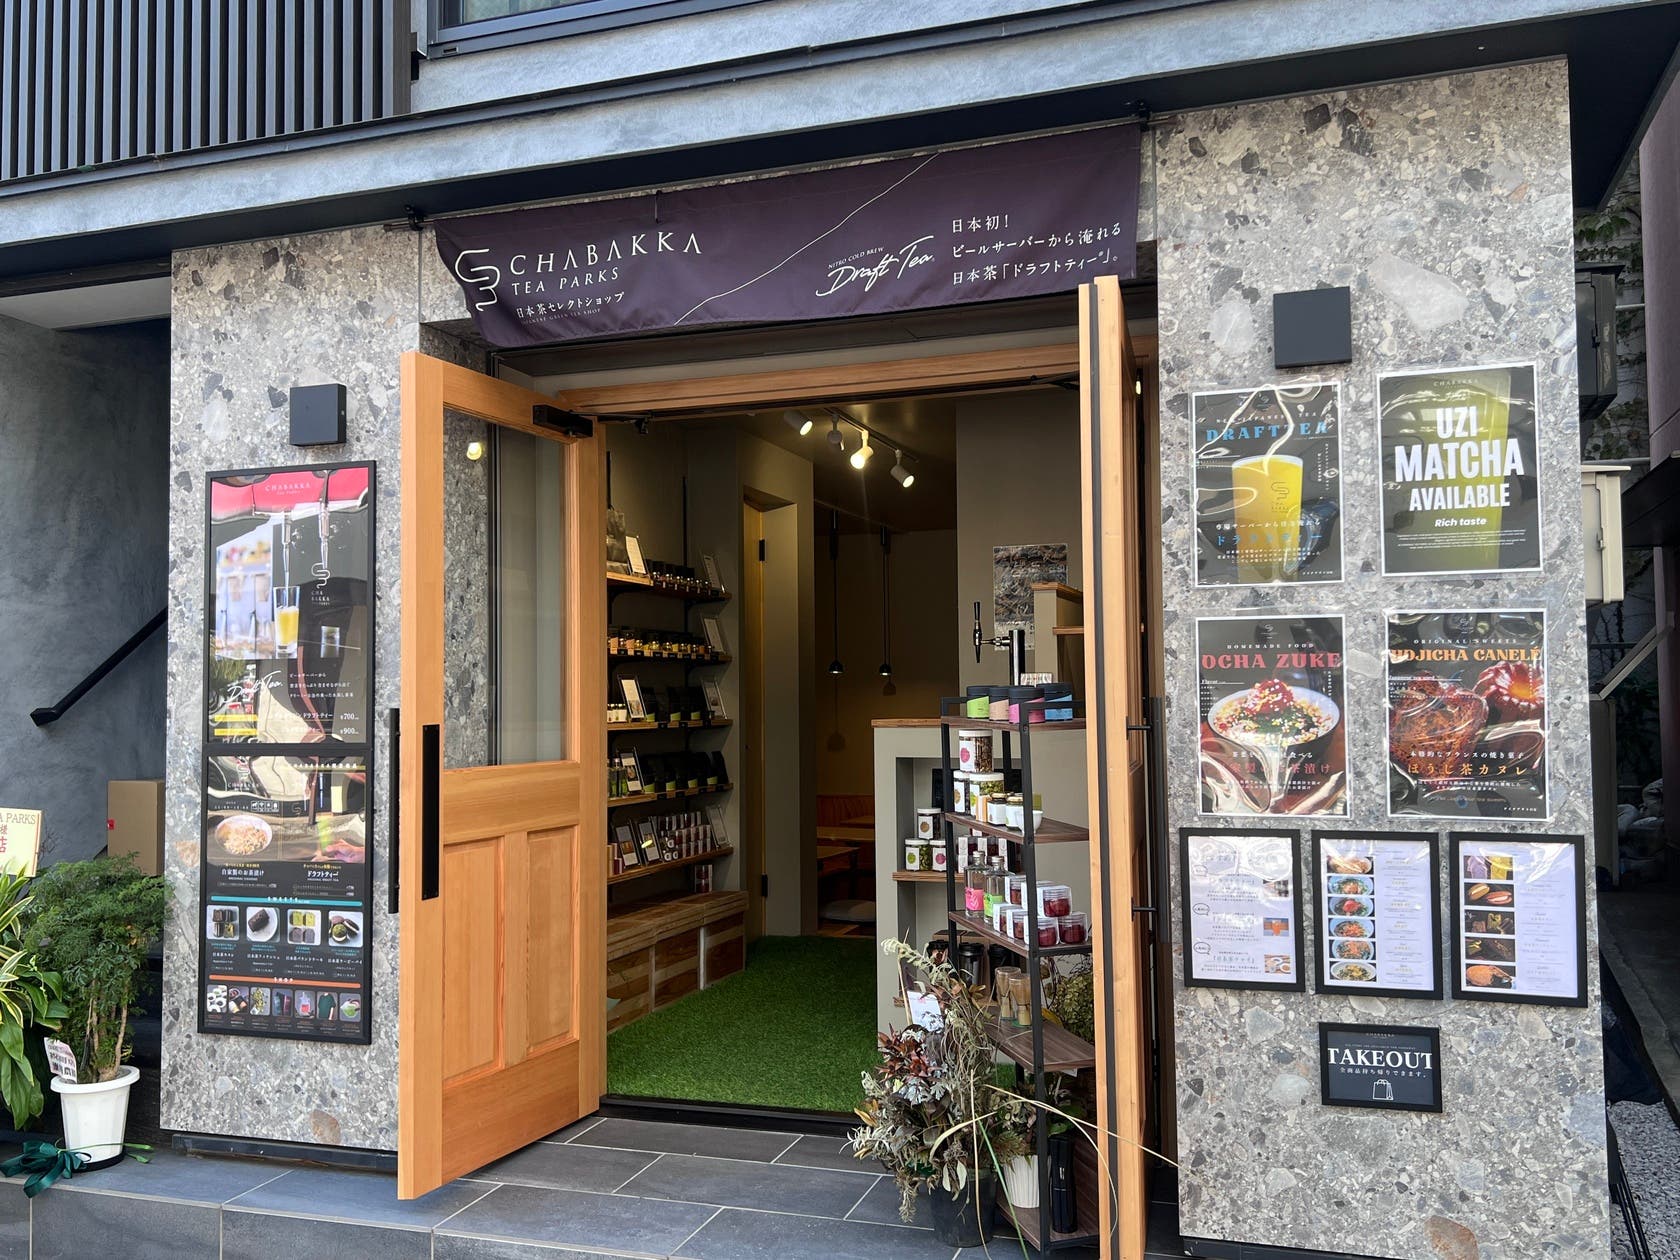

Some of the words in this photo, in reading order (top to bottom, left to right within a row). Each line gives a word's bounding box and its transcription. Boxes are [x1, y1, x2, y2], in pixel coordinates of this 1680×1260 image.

[509, 231, 702, 276] CHABAKKA
[952, 222, 1121, 259] ビールサーバーから淹れる
[815, 253, 899, 297] Draft
[897, 235, 934, 279] Tea
[828, 258, 847, 268] NITRO
[847, 251, 865, 262] COLD
[866, 246, 884, 256] BREW
[512, 281, 545, 296] TEA
[559, 266, 620, 290] PARKS
[516, 291, 625, 319] 日本茶セレクトショップ
[1206, 424, 1280, 442] DRAFT
[1283, 419, 1329, 436] EA
[1436, 406, 1477, 440] UZI
[1394, 438, 1525, 482] MATCHA
[1409, 483, 1511, 511] AVAILABLE
[1435, 518, 1457, 528] Rich
[1459, 516, 1487, 526] taste
[1201, 653, 1266, 670] OCHA
[1276, 652, 1342, 669] ZUKE
[1407, 763, 1527, 775] ほうじ茶カヌレ
[7, 812, 36, 824] PARKS
[1327, 1047, 1433, 1070] TAKEOUT
